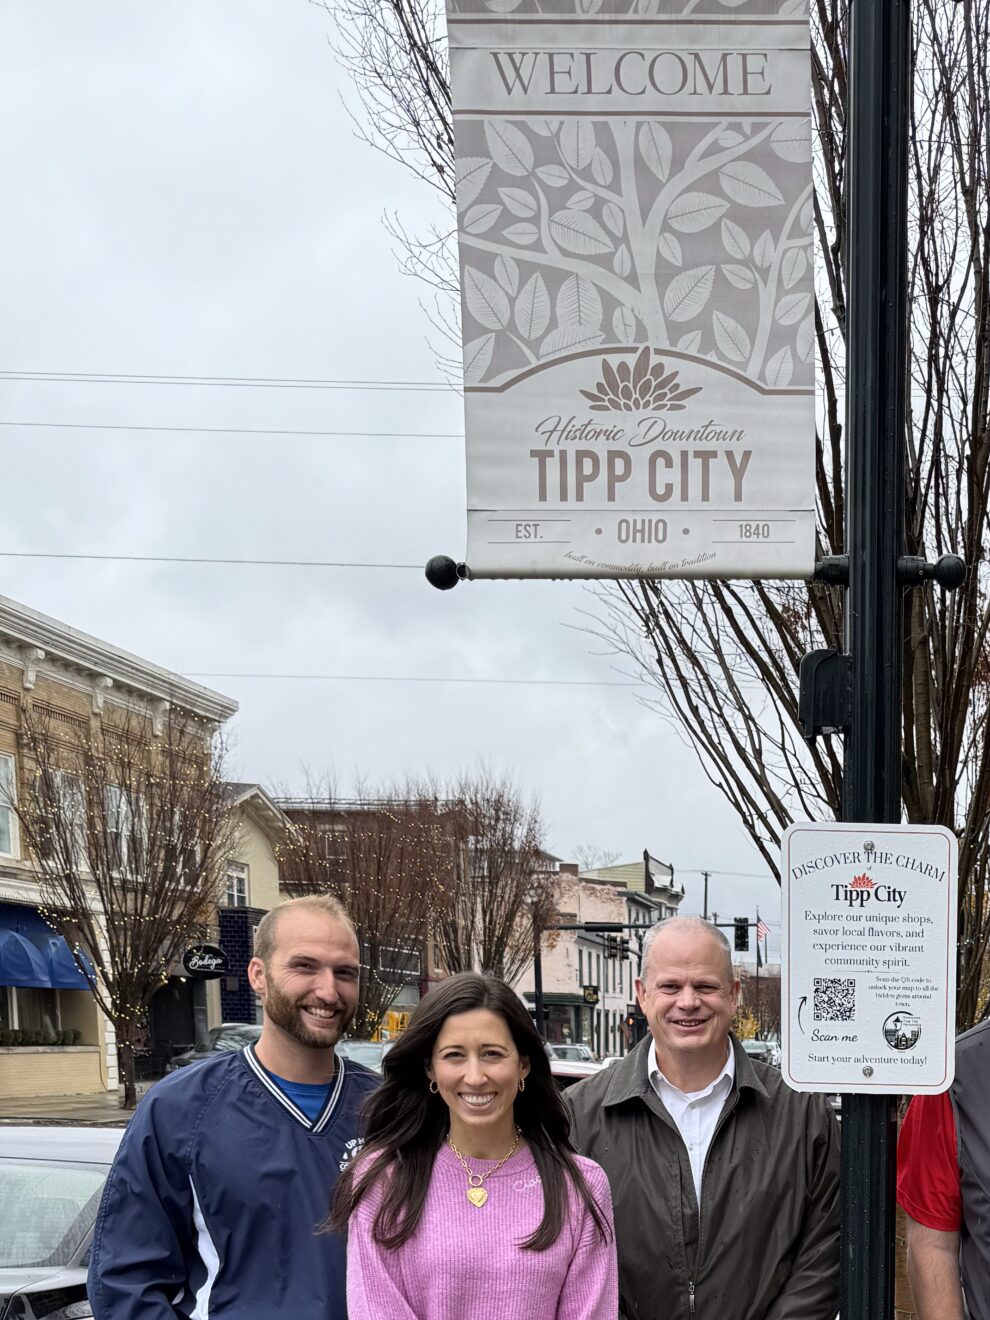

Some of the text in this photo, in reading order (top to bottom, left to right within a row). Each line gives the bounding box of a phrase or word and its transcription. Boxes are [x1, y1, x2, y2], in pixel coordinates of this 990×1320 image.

[489, 50, 772, 96] WELCOME
[535, 415, 746, 447] Historic Downtown
[530, 449, 753, 502] TIPP CITY
[515, 518, 770, 544] EST. OHIO 1840
[792, 851, 946, 882] DISCOVER THE CHARM
[831, 884, 907, 909] Tipp City
[804, 910, 934, 926] Explore our unique shops,
[812, 926, 924, 938] savor local flavors, and
[812, 940, 925, 953] experience our vibrant
[189, 954, 223, 970] Bodega
[824, 956, 910, 970] community spirit.
[811, 1028, 858, 1042] Scan me
[808, 1053, 927, 1067] Start your adventure today!
